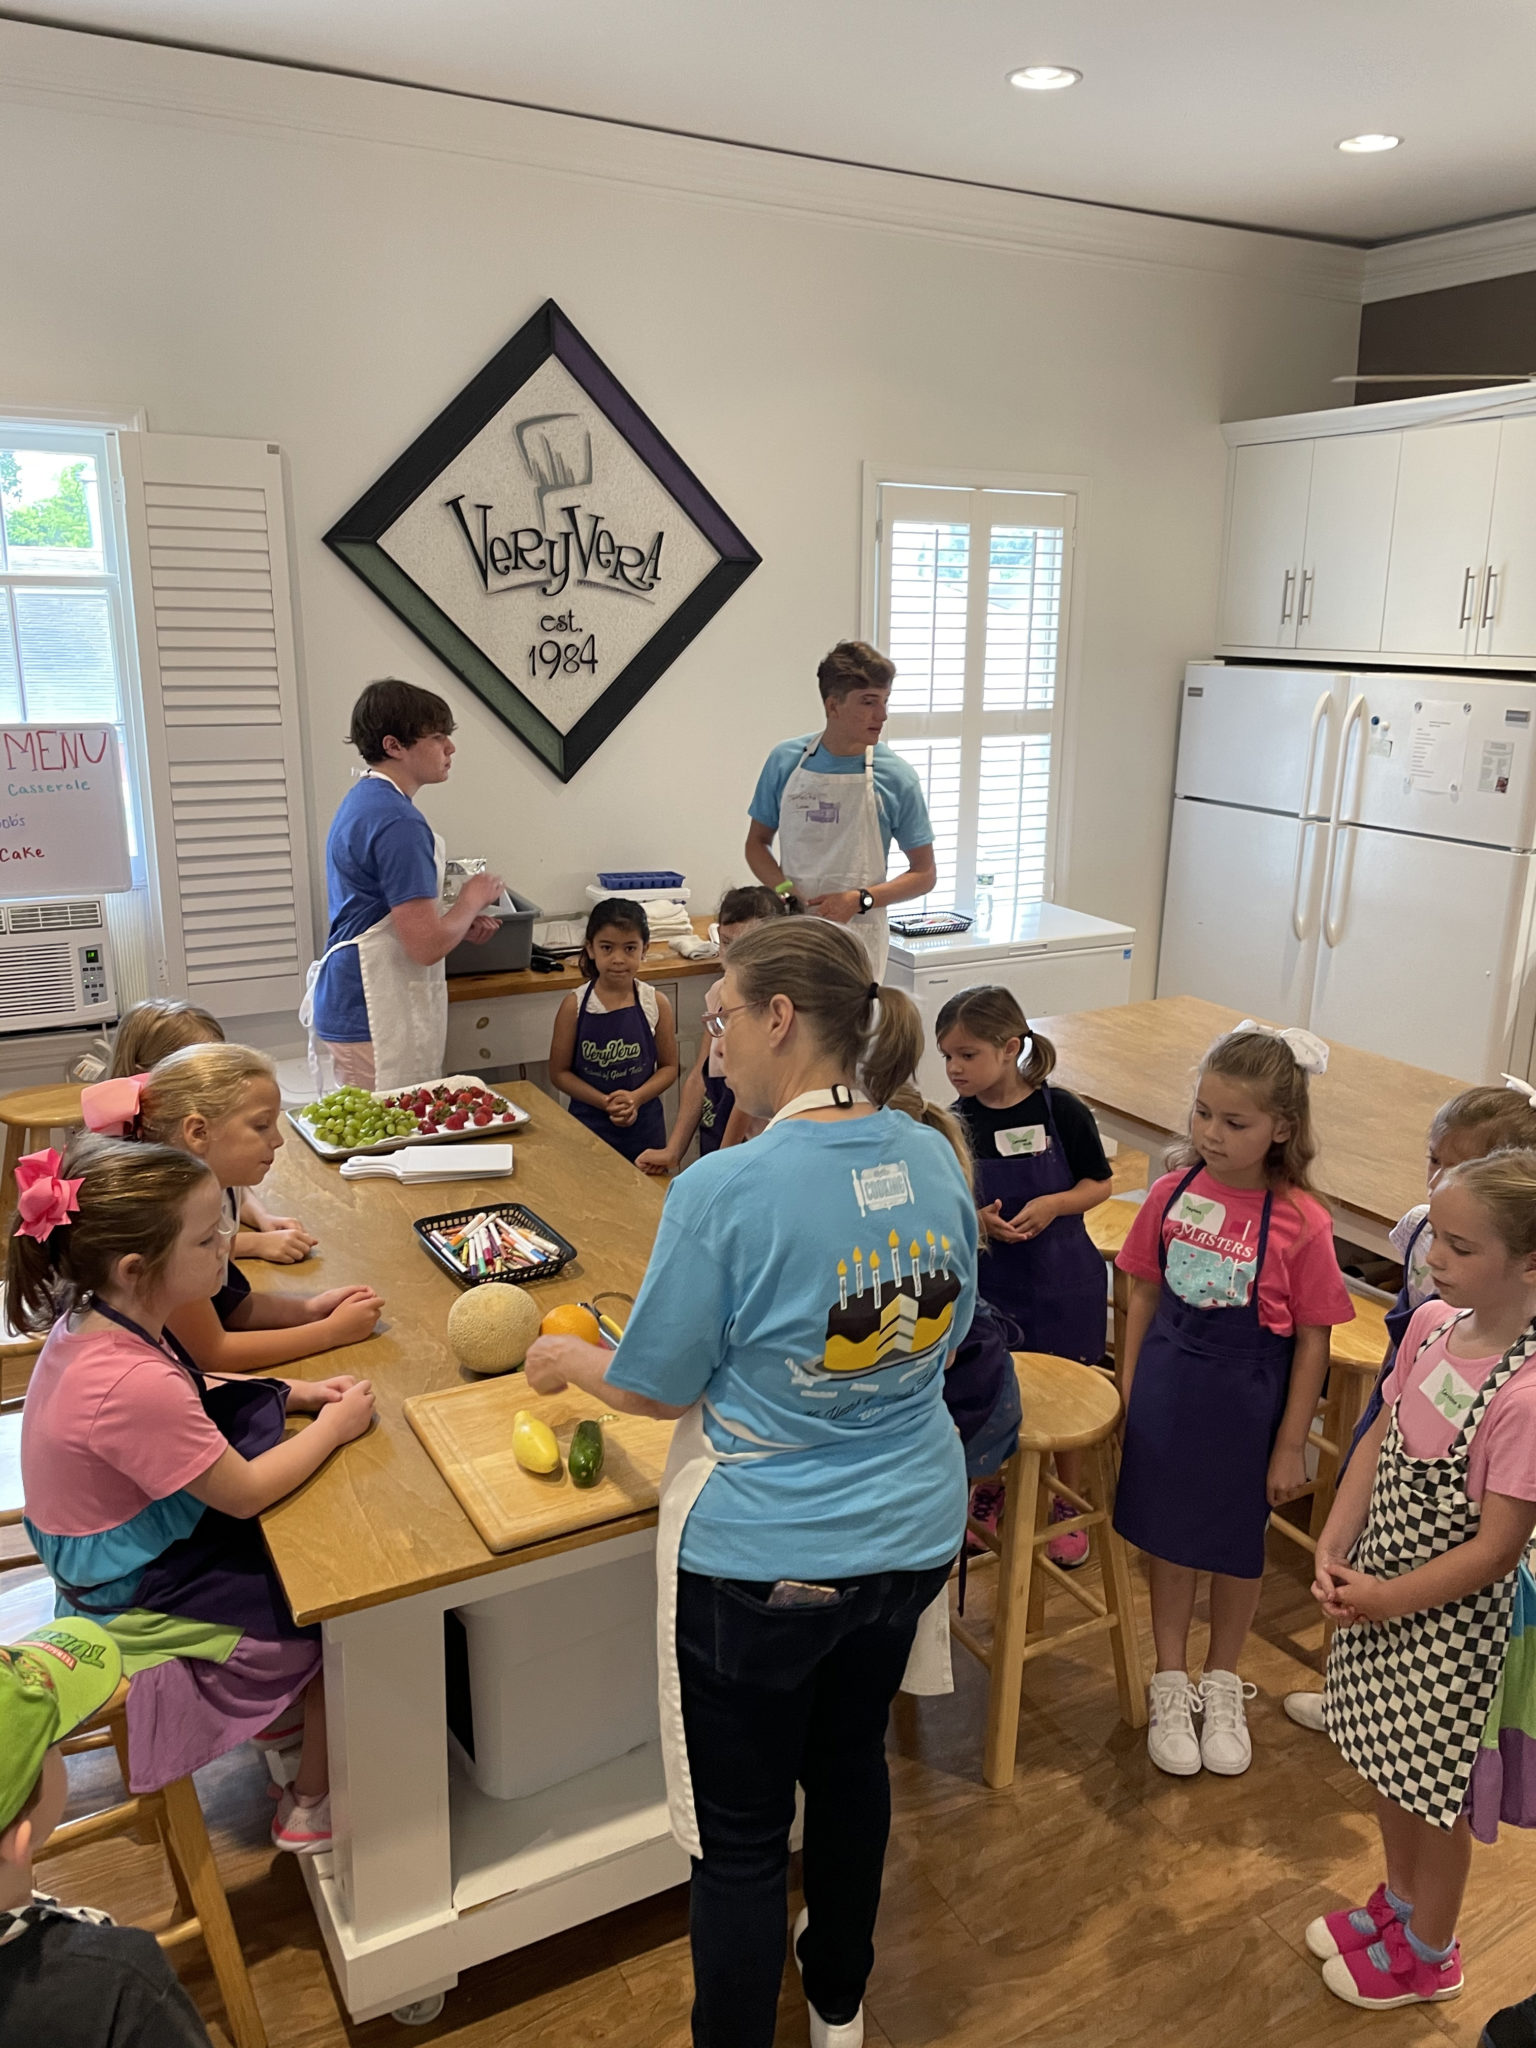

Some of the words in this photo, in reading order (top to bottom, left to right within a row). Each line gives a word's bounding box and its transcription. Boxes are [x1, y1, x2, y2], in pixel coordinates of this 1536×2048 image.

[540, 609, 583, 632] est.
[528, 634, 598, 679] 1984
[3, 730, 107, 771] MENU
[8, 779, 90, 797] Casserole
[1173, 1221, 1254, 1258] MASTERS
